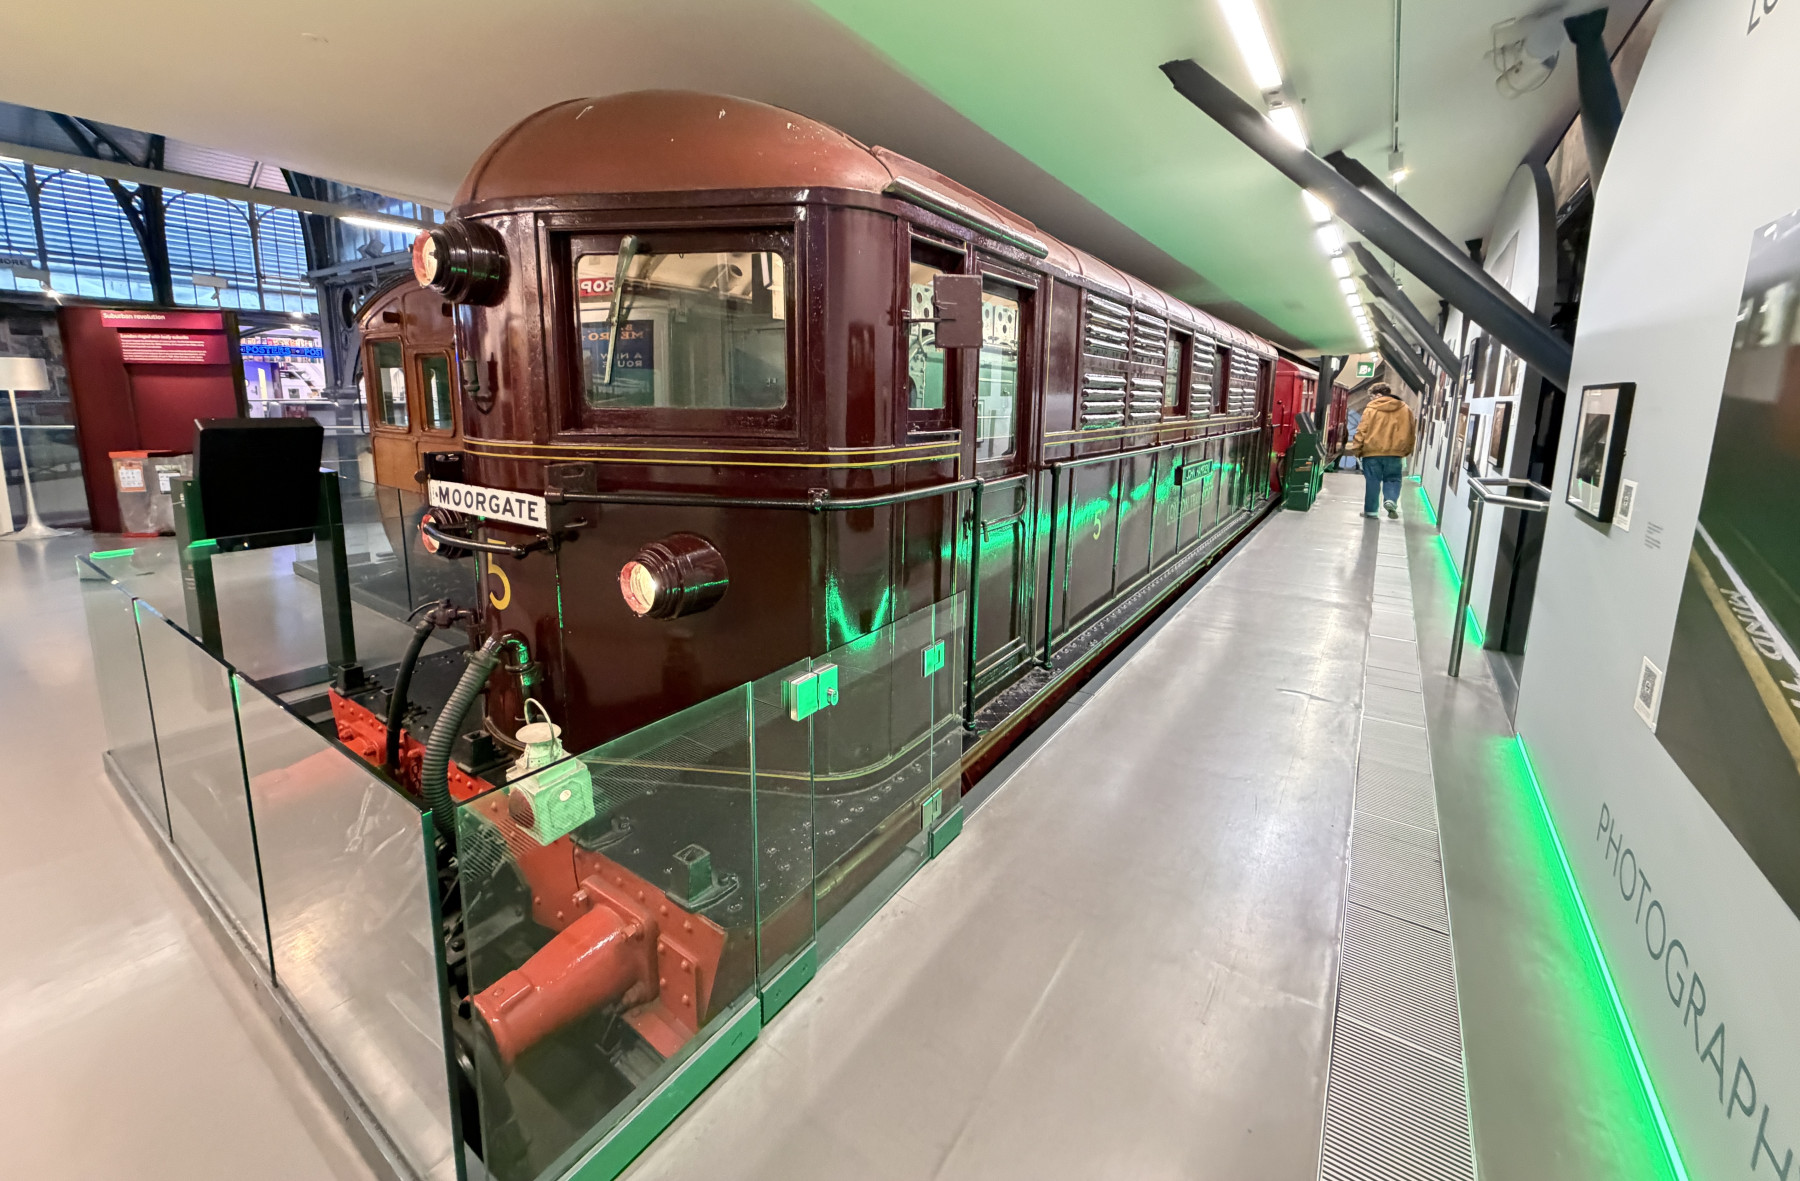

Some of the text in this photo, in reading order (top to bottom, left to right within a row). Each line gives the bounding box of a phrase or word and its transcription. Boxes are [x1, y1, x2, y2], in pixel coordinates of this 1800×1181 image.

[246, 345, 291, 355] POSTERS
[438, 485, 539, 522] MOORGATE
[1093, 510, 1101, 540] 5
[487, 538, 511, 610] 5
[1720, 588, 1782, 661] MIND
